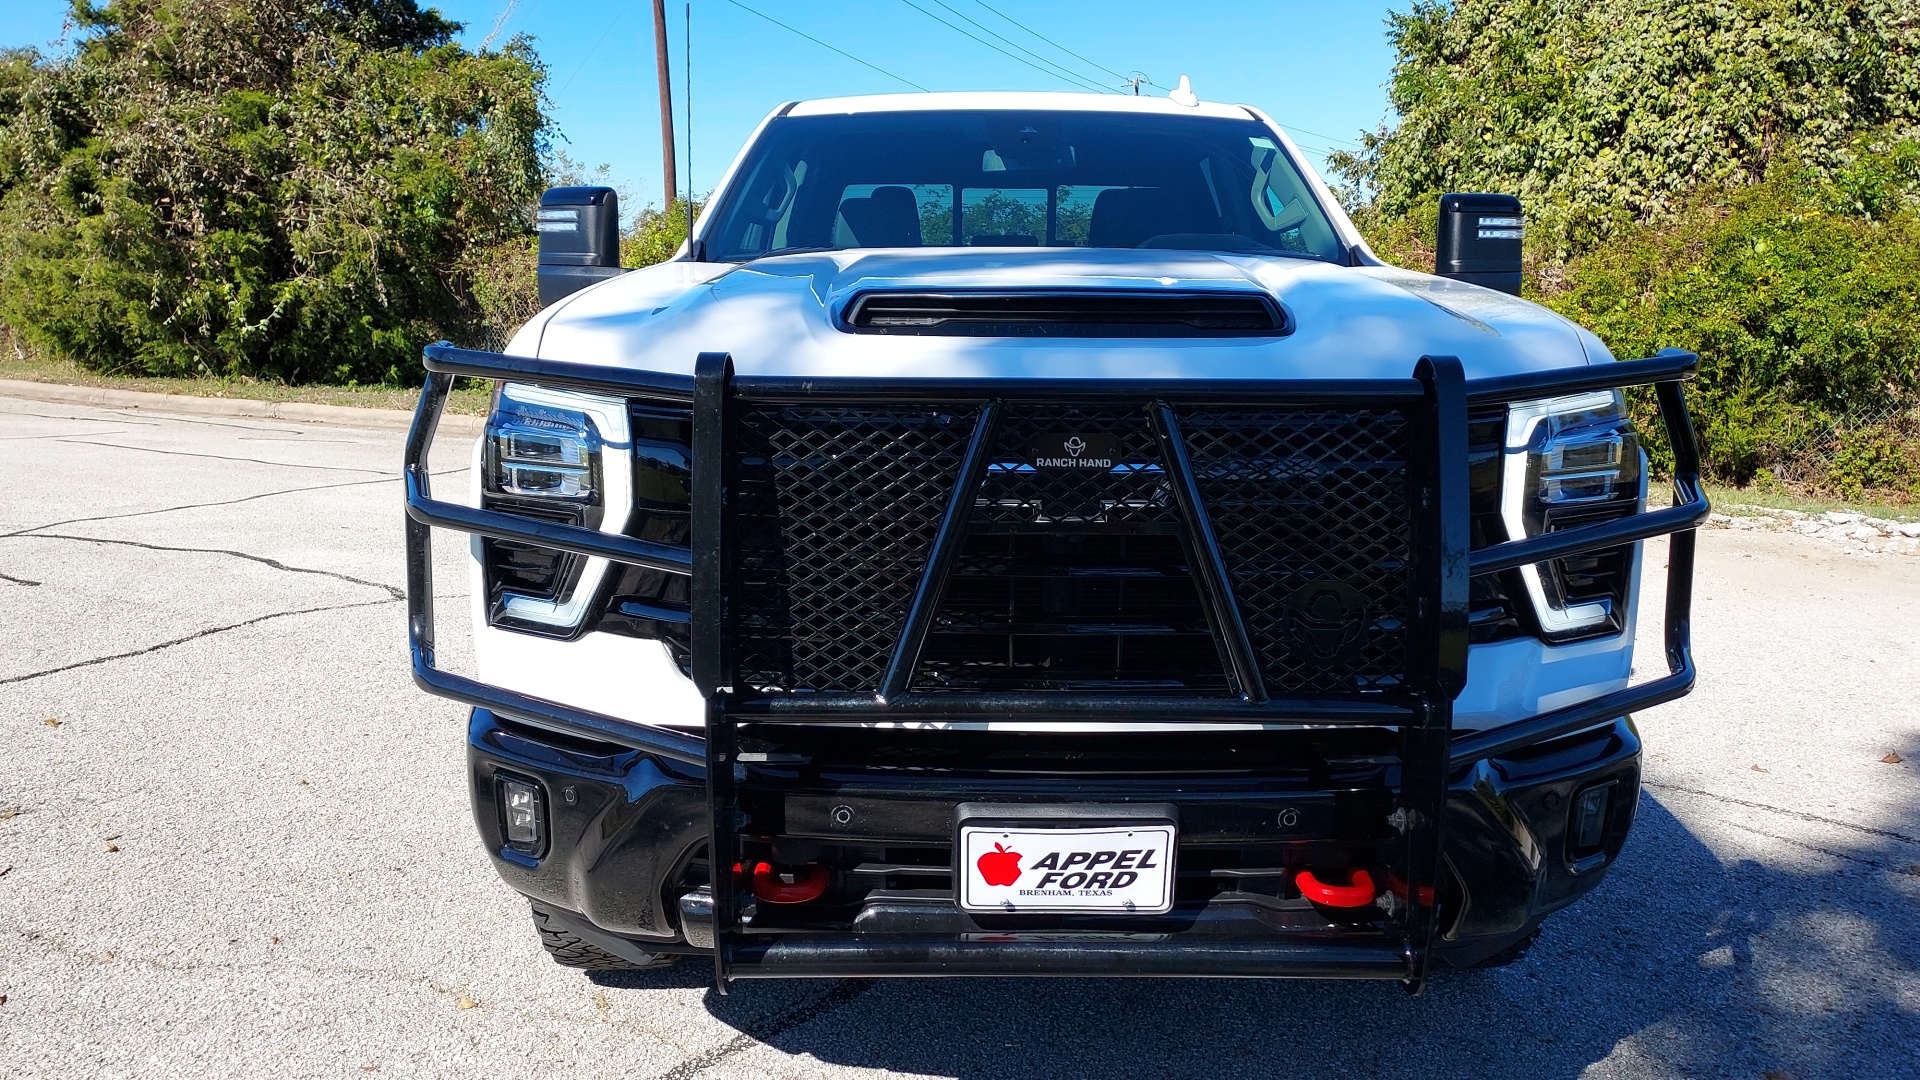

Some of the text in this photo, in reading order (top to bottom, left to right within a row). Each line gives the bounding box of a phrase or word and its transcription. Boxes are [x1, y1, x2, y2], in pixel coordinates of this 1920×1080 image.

[1036, 458, 1111, 468] RANCH HAND
[1030, 849, 1157, 870] APPEL
[1035, 871, 1139, 889] FORD
[1019, 889, 1113, 897] BRENHAM, TEXAS
